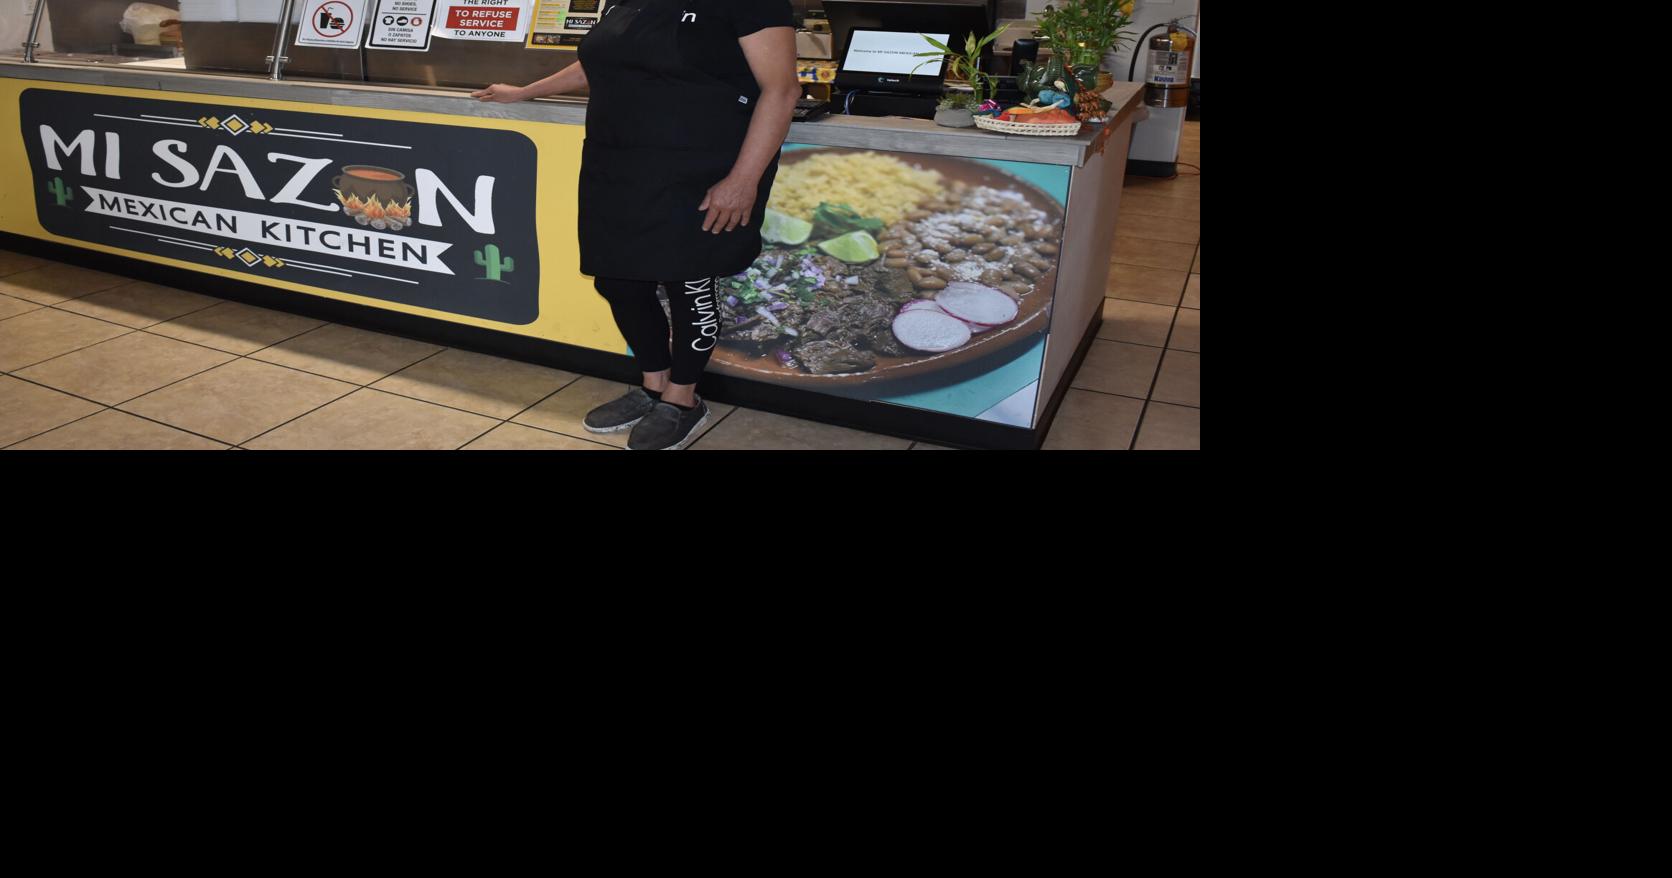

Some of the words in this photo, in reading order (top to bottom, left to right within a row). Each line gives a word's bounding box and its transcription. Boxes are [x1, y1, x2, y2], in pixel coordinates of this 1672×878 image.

[460, 19, 504, 28] SERVICE
[472, 10, 513, 19] REFUSE
[468, 30, 506, 38] ANYONE
[39, 124, 120, 180] MI
[97, 193, 238, 234] MEXICAN
[260, 220, 428, 264] KITCHEN
[691, 294, 718, 351] Calvin
